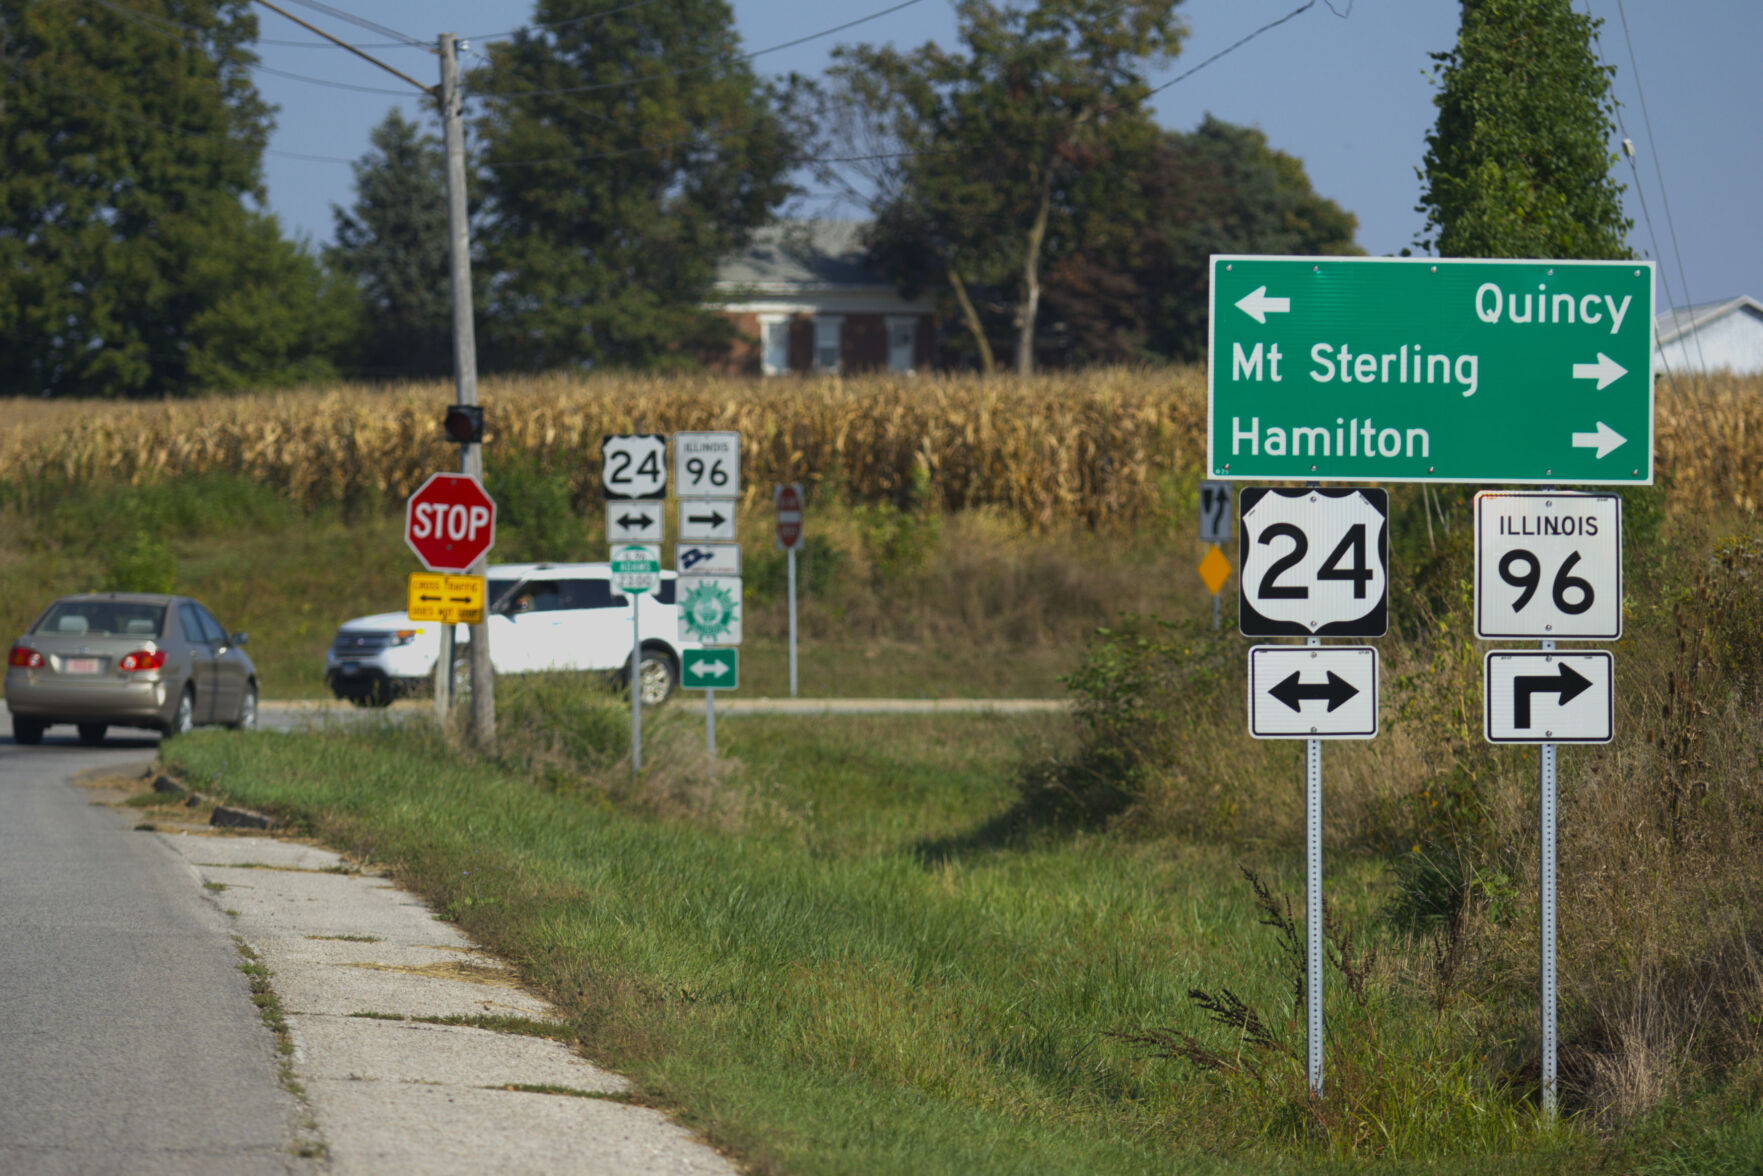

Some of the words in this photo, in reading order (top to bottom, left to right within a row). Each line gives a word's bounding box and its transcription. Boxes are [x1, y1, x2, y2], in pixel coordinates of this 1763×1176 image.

[1475, 282, 1633, 335] Quincy
[1232, 342, 1283, 383] Mt
[1309, 342, 1479, 397] Sterling
[684, 442, 729, 453] ILLINOIS
[1232, 417, 1430, 458] Hamilton
[610, 449, 661, 484] 24
[686, 457, 728, 487] 96
[412, 502, 490, 542] STOP
[1499, 515, 1599, 537] ILLINOIS
[1257, 522, 1374, 600] 24
[1498, 548, 1596, 616] 96
